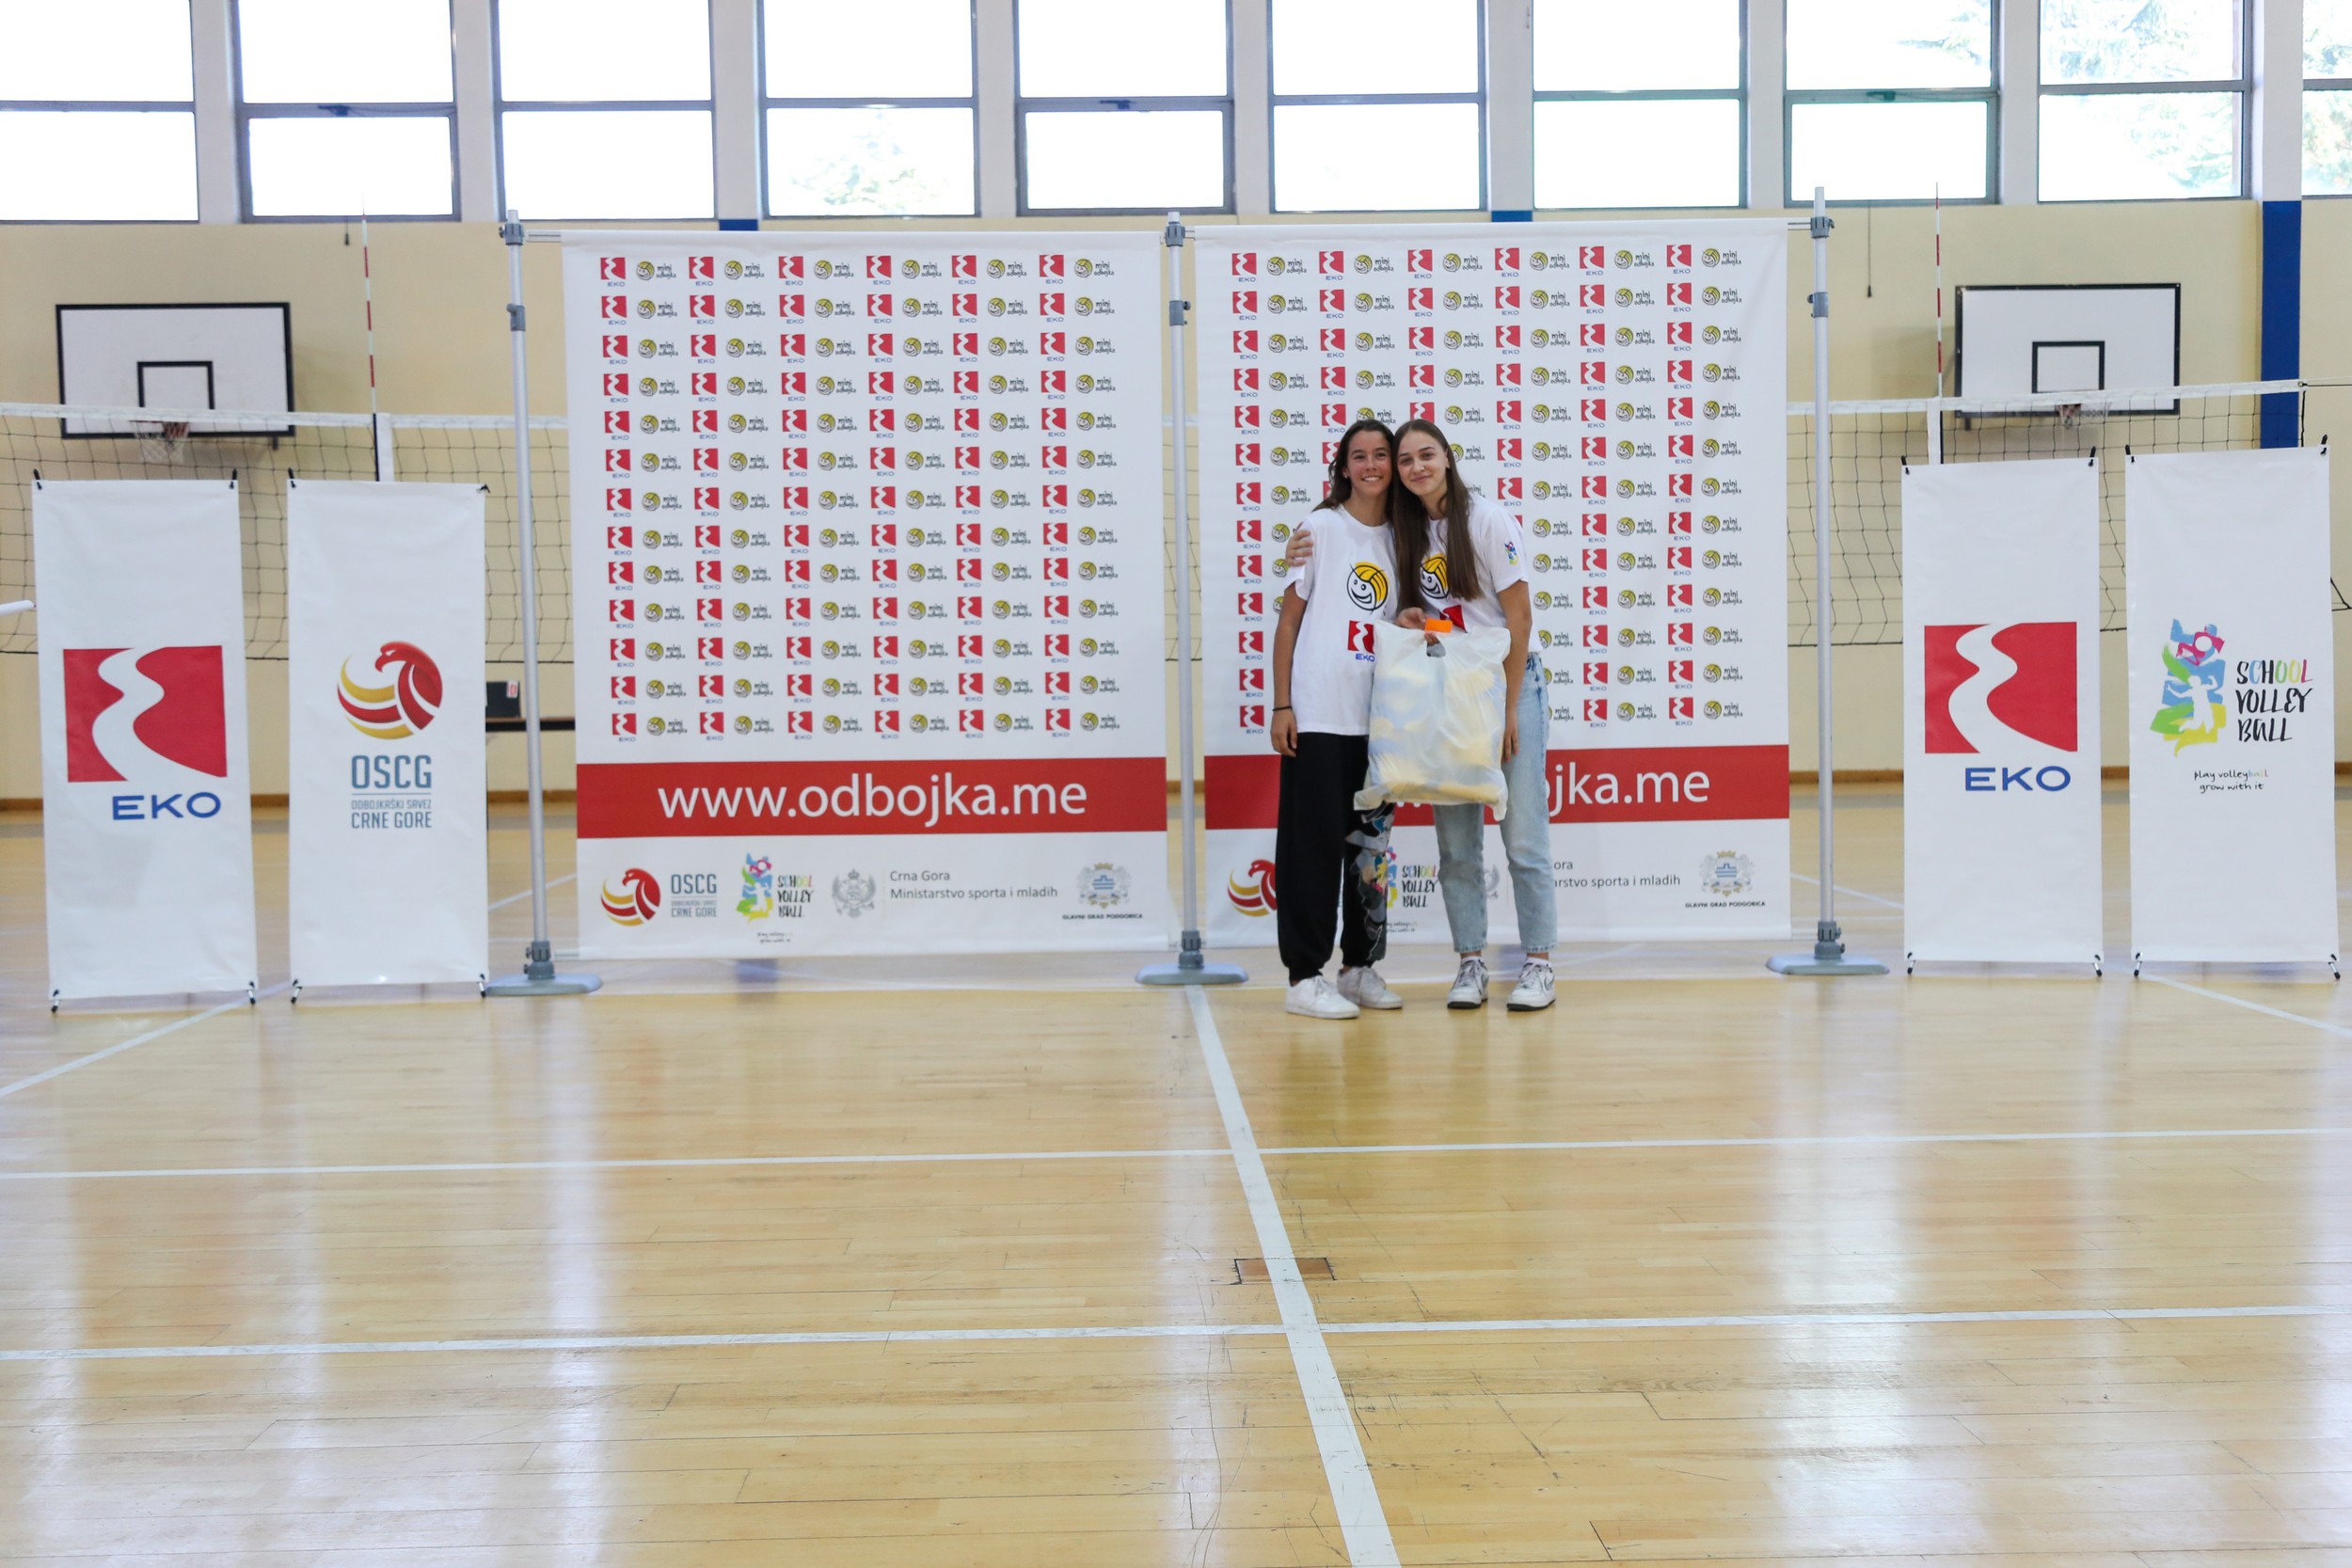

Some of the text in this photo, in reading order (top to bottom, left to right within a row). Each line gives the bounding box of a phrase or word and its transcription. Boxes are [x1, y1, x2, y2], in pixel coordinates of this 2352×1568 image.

[1356, 653, 1375, 662] EKO
[2236, 658, 2313, 685] SCHOOL
[2234, 688, 2313, 715] VOLLEY
[351, 754, 432, 789] OSCG
[1964, 766, 2072, 792] EKO
[2194, 769, 2216, 783] play
[2200, 784, 2224, 794] grow
[2254, 782, 2265, 790] it
[112, 792, 222, 820] EKO
[658, 772, 1089, 828] www.odbojka.me
[351, 812, 432, 829] CRNE GORE
[890, 870, 950, 881] Crna Gora
[1402, 864, 1438, 879] SCHOOL
[671, 874, 717, 895] OSCG
[777, 875, 814, 889] SCHOOL
[1402, 879, 1439, 894] VOLLEY
[1591, 876, 1629, 890] sporta
[1633, 875, 1637, 887] i
[1640, 874, 1681, 887] mladih
[777, 889, 815, 903] VOLLEY
[890, 887, 1058, 901] Ministarstvo sporta i mladih
